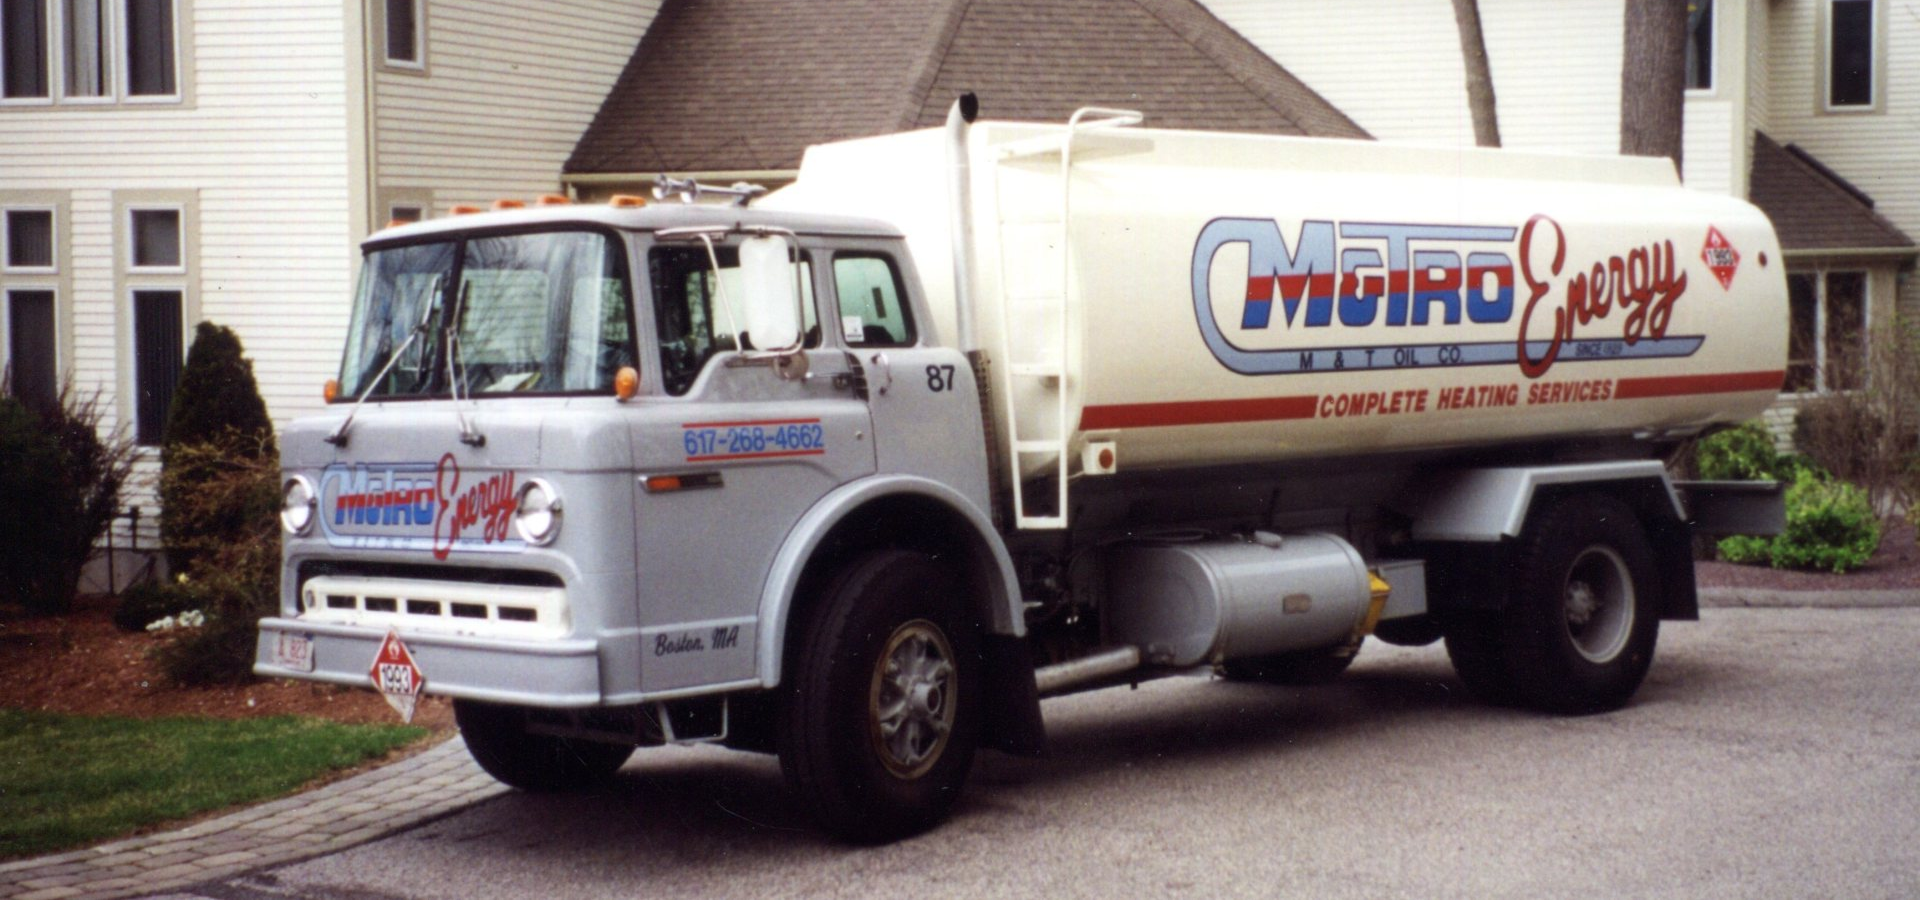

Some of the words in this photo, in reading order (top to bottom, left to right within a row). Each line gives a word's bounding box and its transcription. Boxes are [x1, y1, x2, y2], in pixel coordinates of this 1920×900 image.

[1707, 247, 1734, 266] 1993
[1517, 213, 1687, 379] Energy
[1299, 351, 1313, 371] M
[1333, 350, 1344, 370] &
[1365, 349, 1375, 368] T
[1393, 347, 1419, 367] OIL
[1438, 345, 1465, 364] CO.
[926, 364, 956, 392] 87
[1319, 389, 1429, 419] COMPLETE
[1437, 384, 1518, 409] HEATING
[1527, 379, 1613, 405] SERVICES
[684, 424, 825, 456] 617-268-4662
[433, 452, 517, 562] Energy
[712, 624, 740, 650] MA
[381, 664, 411, 693] 1993
